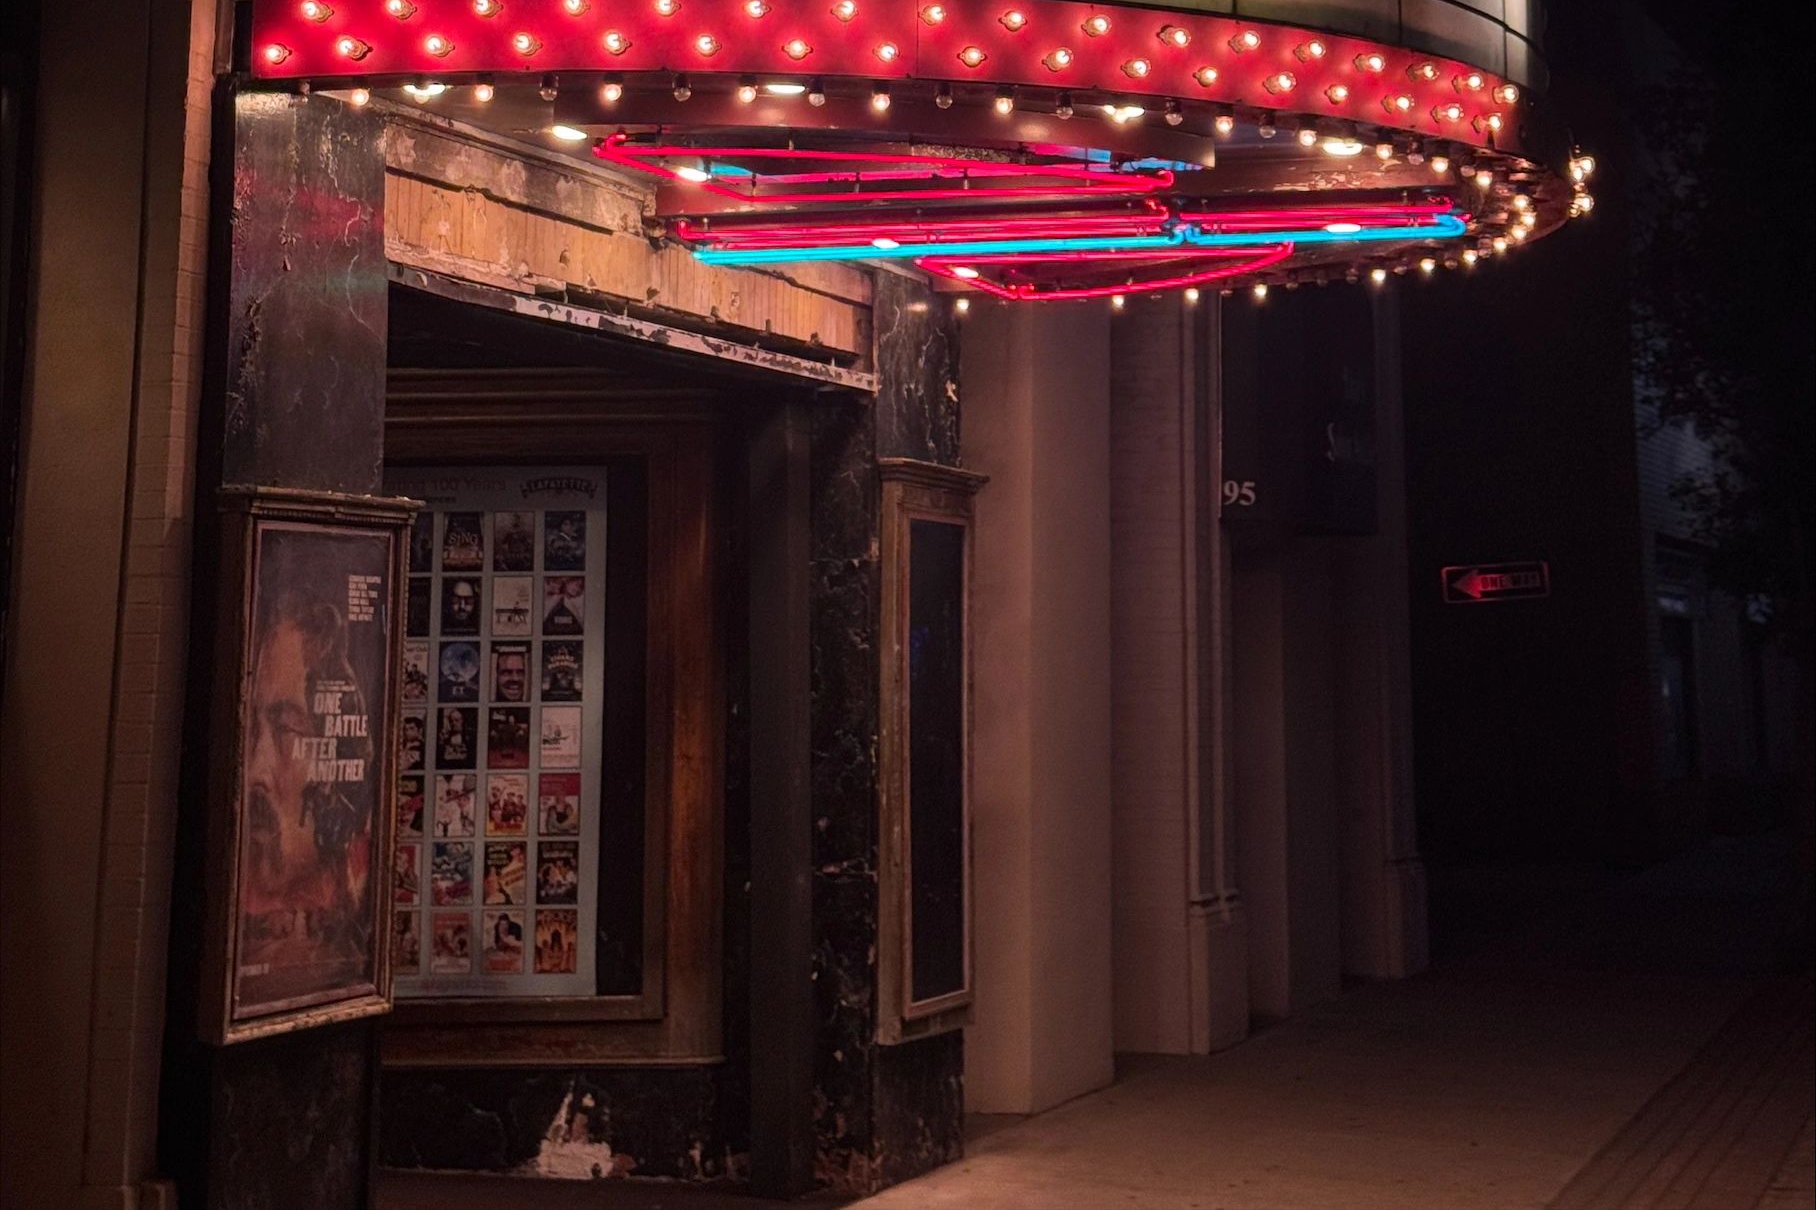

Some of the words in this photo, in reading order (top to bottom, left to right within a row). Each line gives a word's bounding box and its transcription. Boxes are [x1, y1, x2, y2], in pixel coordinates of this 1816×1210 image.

[1223, 480, 1256, 506] 95
[448, 532, 479, 546] SING
[1480, 575, 1506, 590] ONE
[313, 692, 342, 714] ONE
[324, 715, 368, 738] BATTLE
[291, 737, 338, 760] AFTER
[306, 759, 365, 782] ANOTHER
